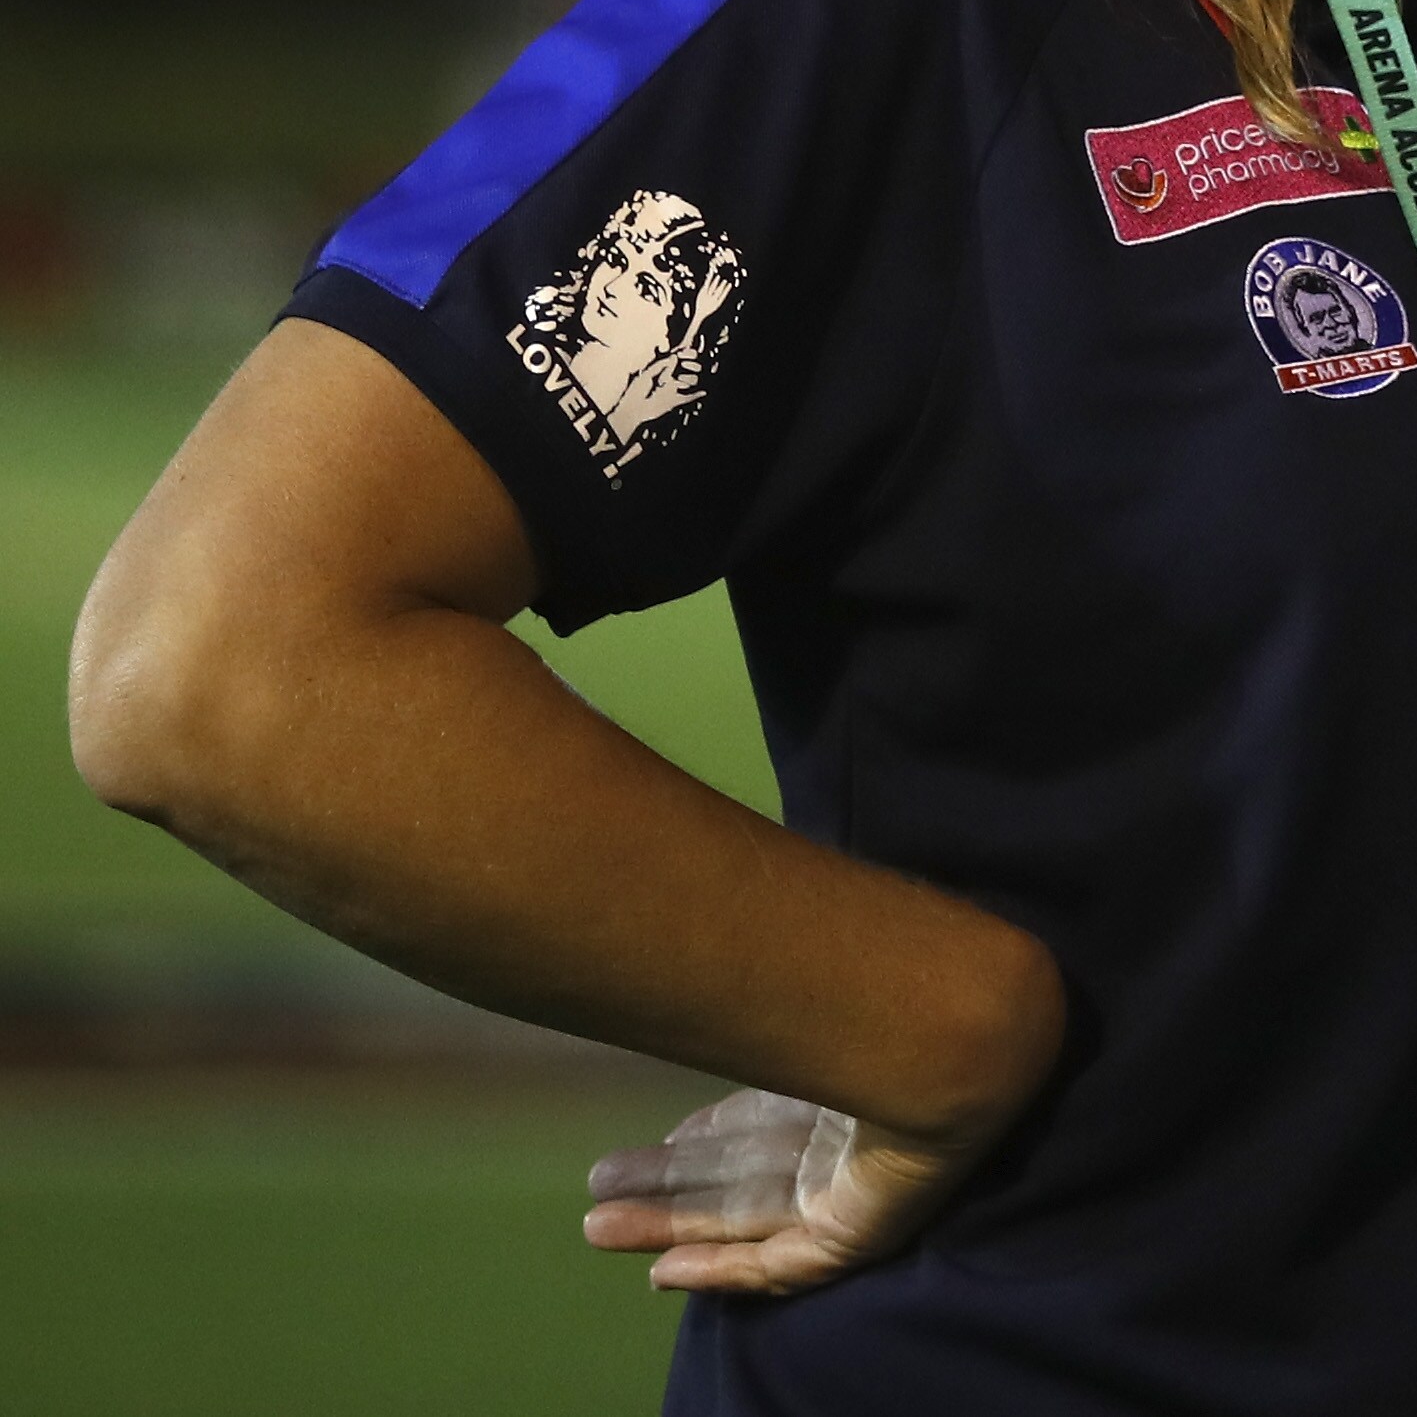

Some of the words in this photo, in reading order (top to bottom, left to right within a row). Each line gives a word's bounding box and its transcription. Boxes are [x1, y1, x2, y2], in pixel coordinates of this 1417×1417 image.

[1348, 8, 1416, 121] ARENA
[1188, 149, 1340, 201] pharmacy
[1253, 250, 1287, 318] BOB
[1295, 244, 1388, 303] JANE
[505, 323, 643, 479] LOVELY!
[1292, 351, 1404, 384] T-MARTS
